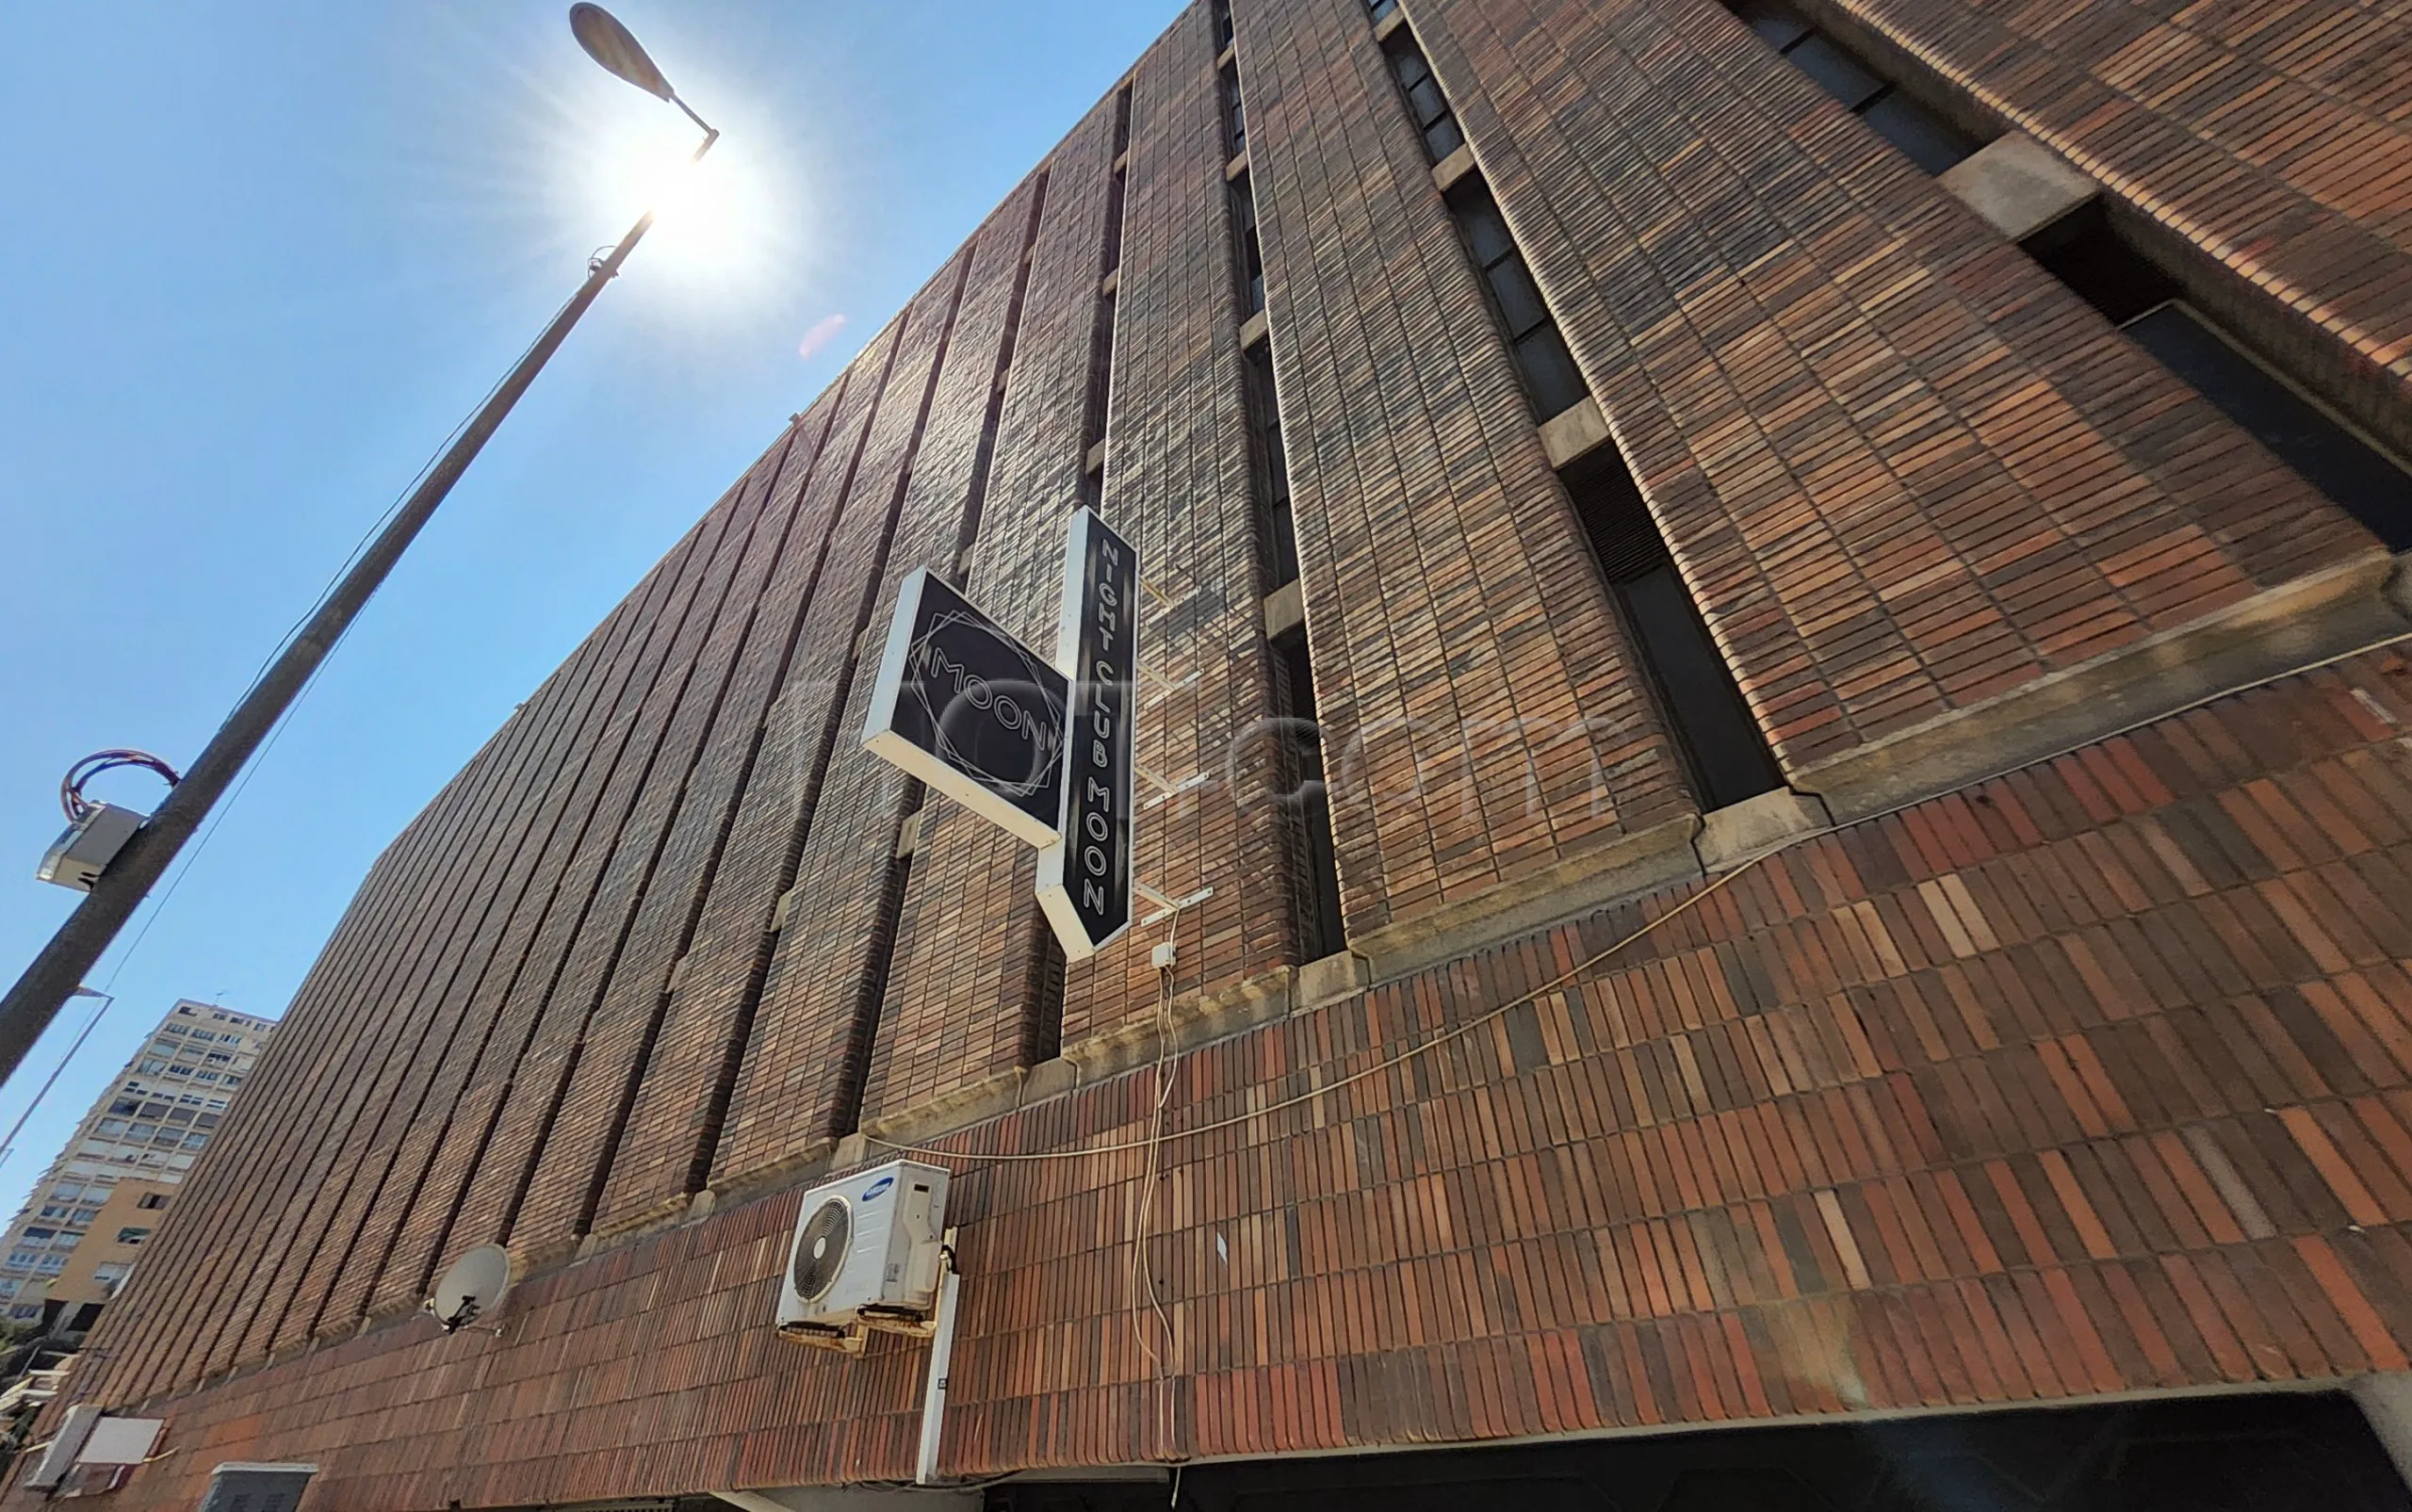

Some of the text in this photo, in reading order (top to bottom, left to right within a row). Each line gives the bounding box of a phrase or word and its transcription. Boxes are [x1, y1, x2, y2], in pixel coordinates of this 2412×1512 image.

[930, 646, 1048, 751] MOON
[1084, 538, 1119, 916] NIGHT CLUB MOON
